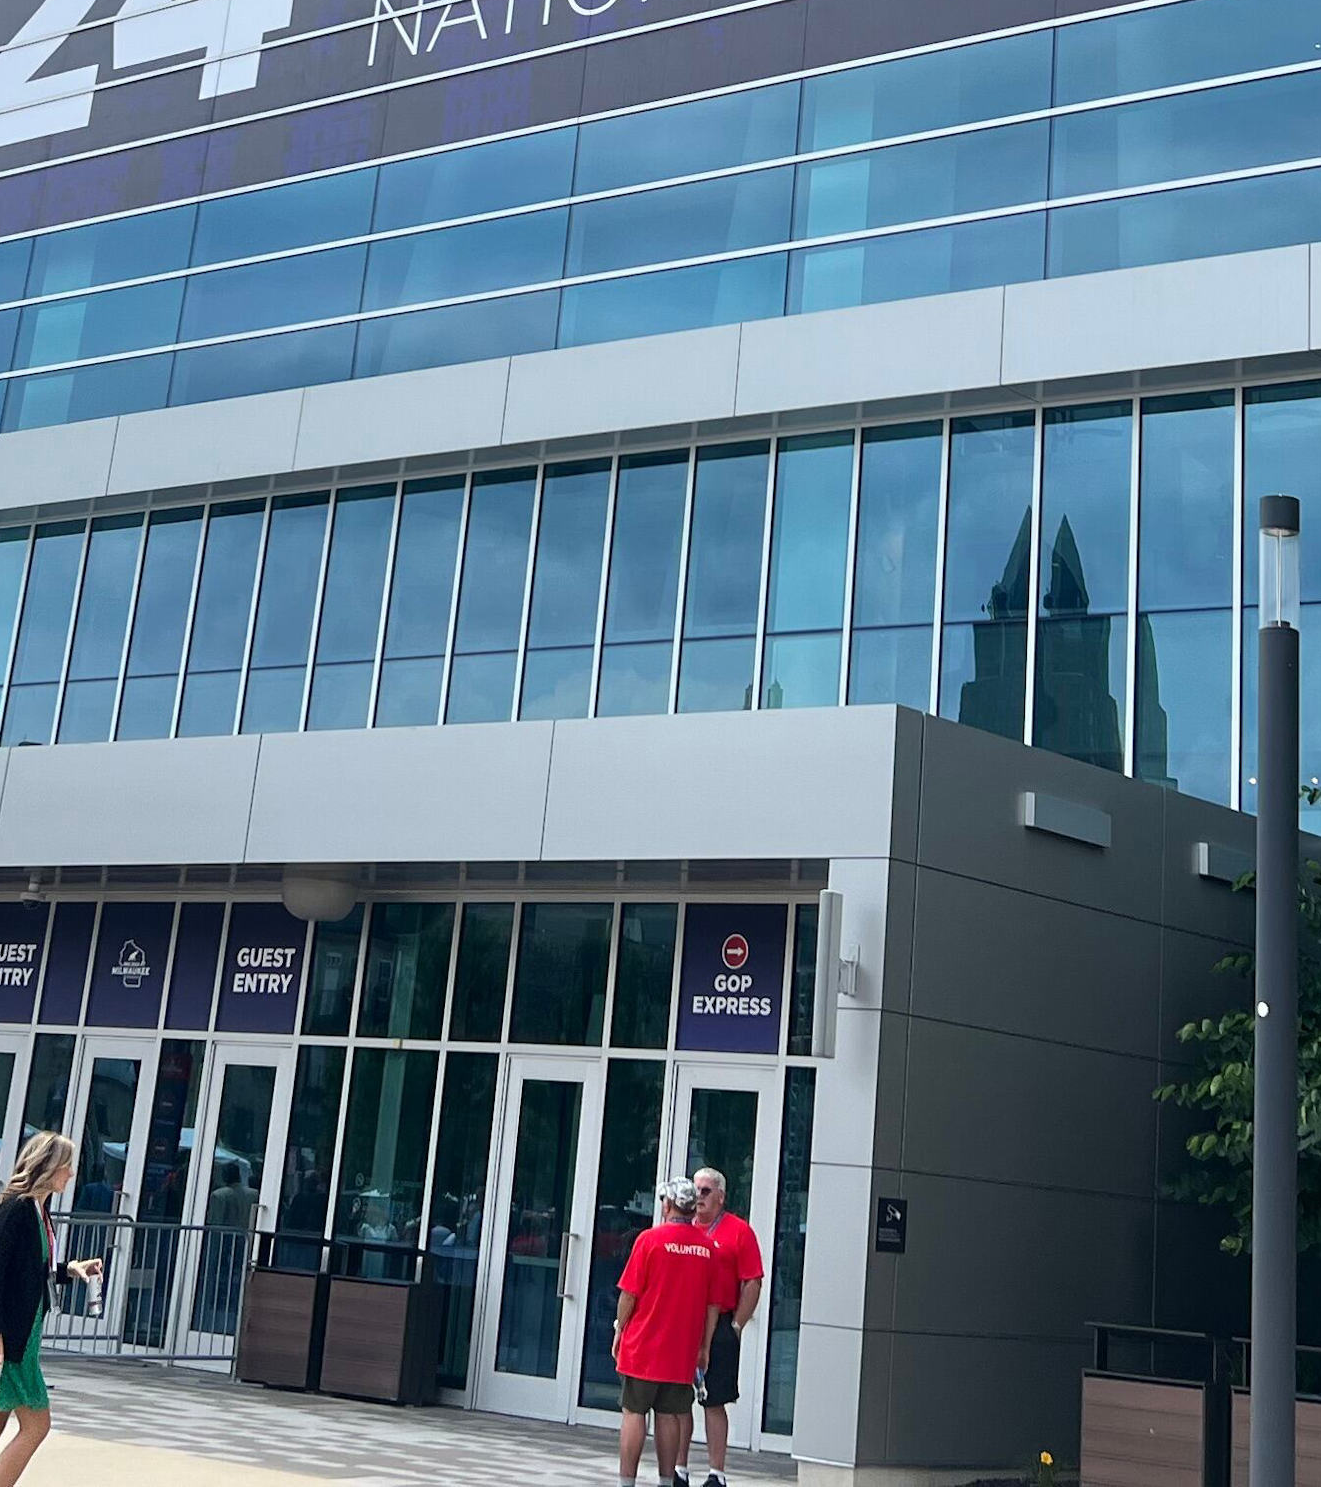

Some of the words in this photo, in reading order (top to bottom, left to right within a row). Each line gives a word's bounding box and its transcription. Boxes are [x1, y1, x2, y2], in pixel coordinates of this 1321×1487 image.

[236, 947, 297, 968] GUEST
[232, 973, 294, 993] ENTRY
[713, 973, 753, 993] GOP
[692, 995, 772, 1016] EXPRESS
[663, 1242, 711, 1260] VOLUNTEER
